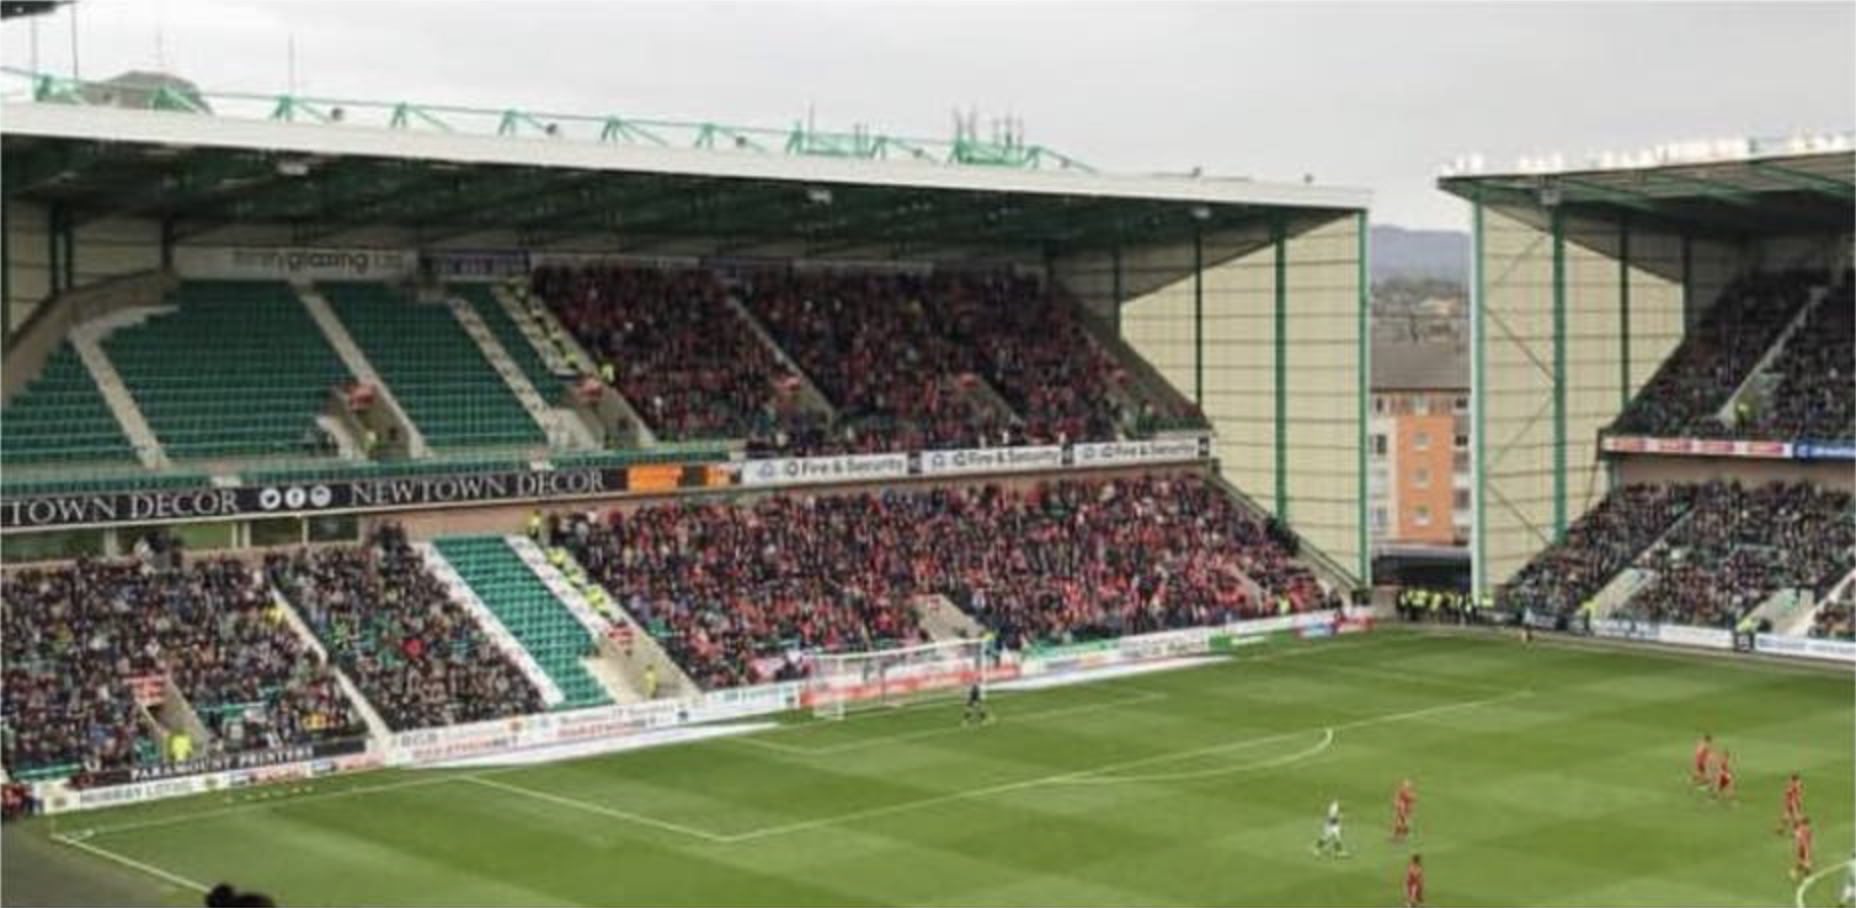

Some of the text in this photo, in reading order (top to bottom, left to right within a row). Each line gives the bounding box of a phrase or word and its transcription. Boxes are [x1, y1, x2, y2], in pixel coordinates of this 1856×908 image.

[802, 462, 829, 475] Fire
[834, 461, 844, 473] &
[847, 457, 904, 472] Security
[997, 452, 1005, 463] &
[351, 471, 506, 504] NEWTOWN
[517, 467, 607, 496] DECOR
[130, 489, 240, 520] DECOR
[239, 745, 313, 767] PRINTERS
